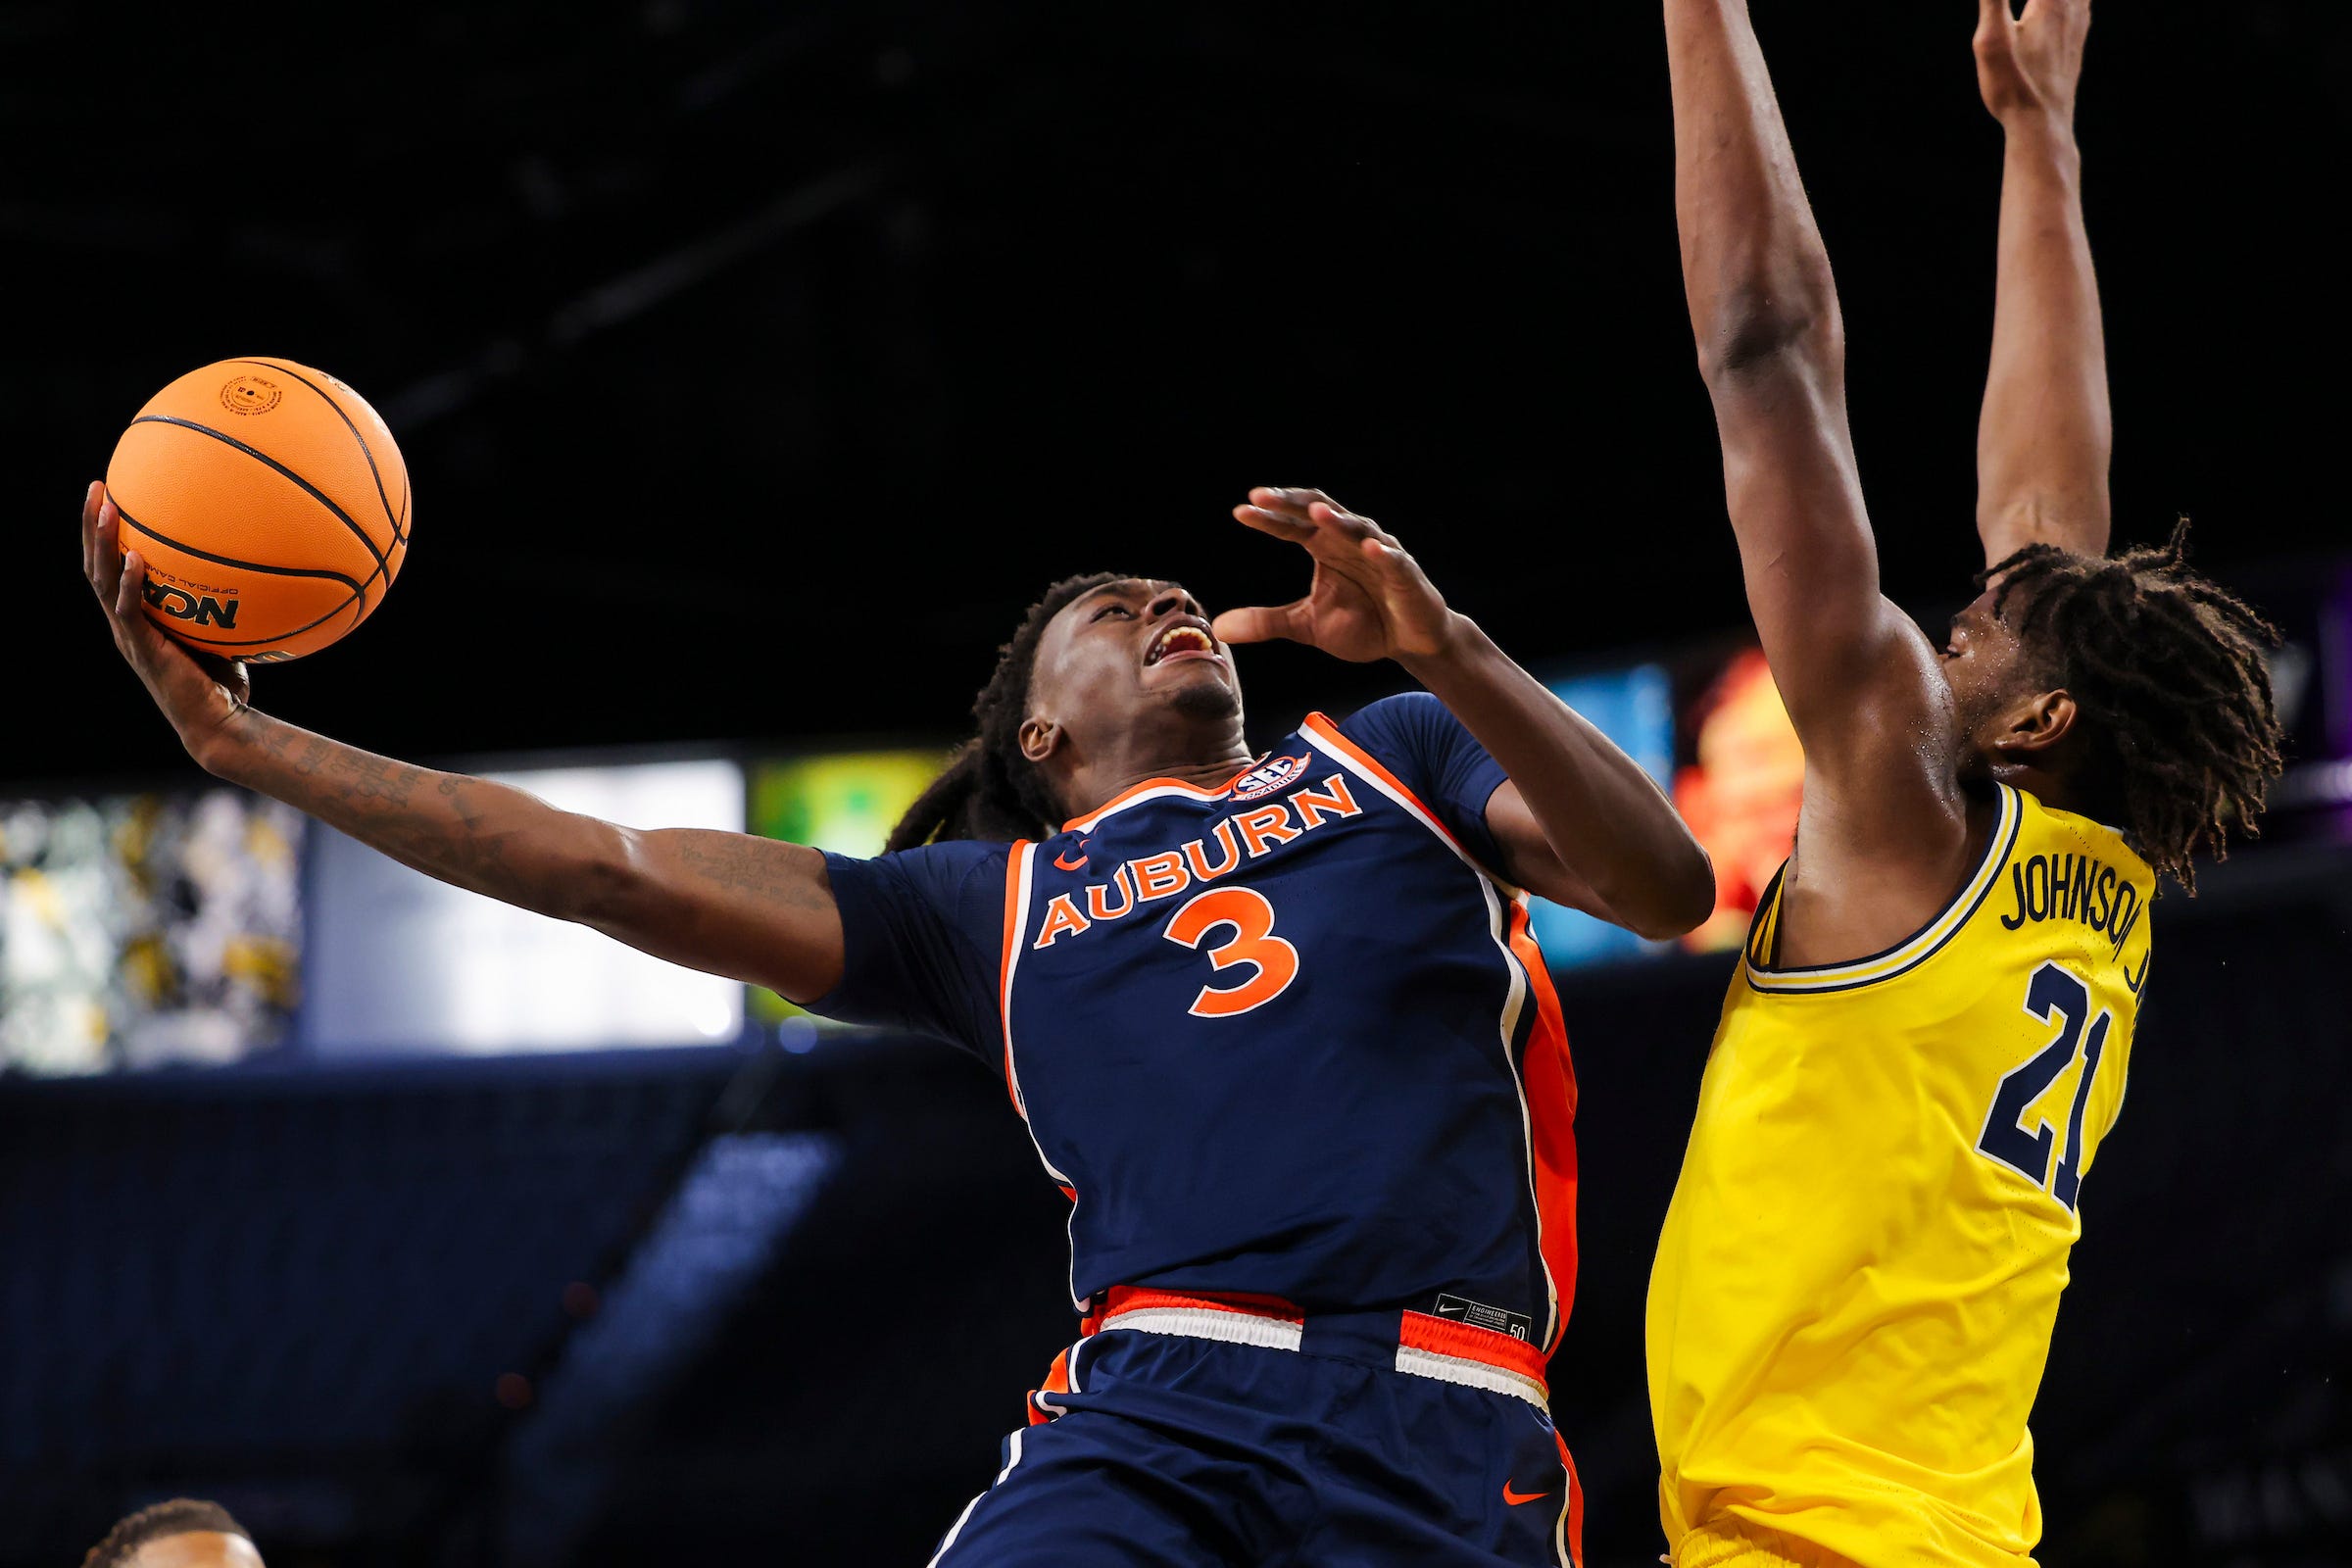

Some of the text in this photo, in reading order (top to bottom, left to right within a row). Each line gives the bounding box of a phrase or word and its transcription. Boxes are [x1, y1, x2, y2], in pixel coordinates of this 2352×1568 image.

[141, 573, 240, 630] NCA
[178, 578, 239, 595] OFFICIAL
[1238, 760, 1293, 792] SEC
[1245, 763, 1305, 800] GRADUATE
[1033, 772, 1363, 951] AUBURN
[1162, 885, 1299, 1018] 3
[1974, 958, 2112, 1218] 21
[1510, 1323, 1526, 1341] 50
